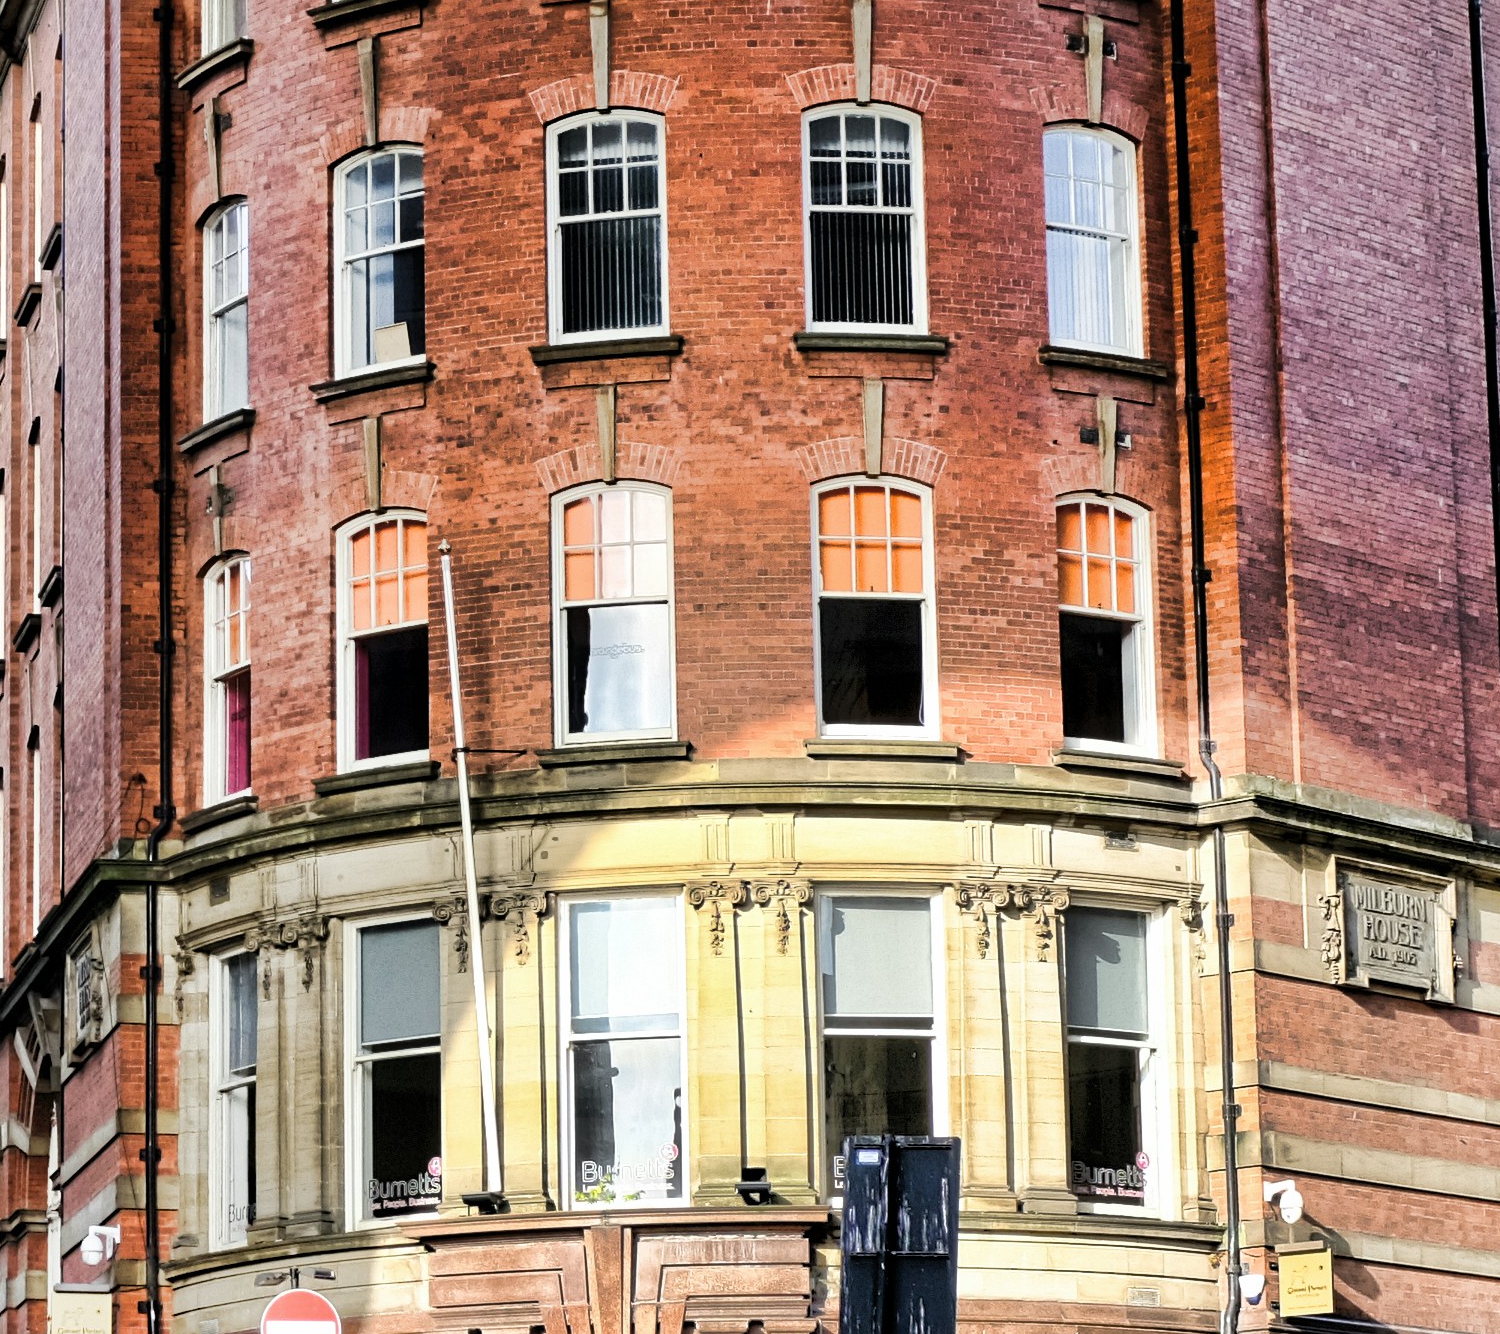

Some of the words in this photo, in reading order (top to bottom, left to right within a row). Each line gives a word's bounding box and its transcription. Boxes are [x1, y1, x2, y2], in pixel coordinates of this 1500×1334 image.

[1350, 886, 1428, 923] MILBURN
[1362, 914, 1424, 951] HOUSE
[368, 1171, 441, 1200] Burnetts
